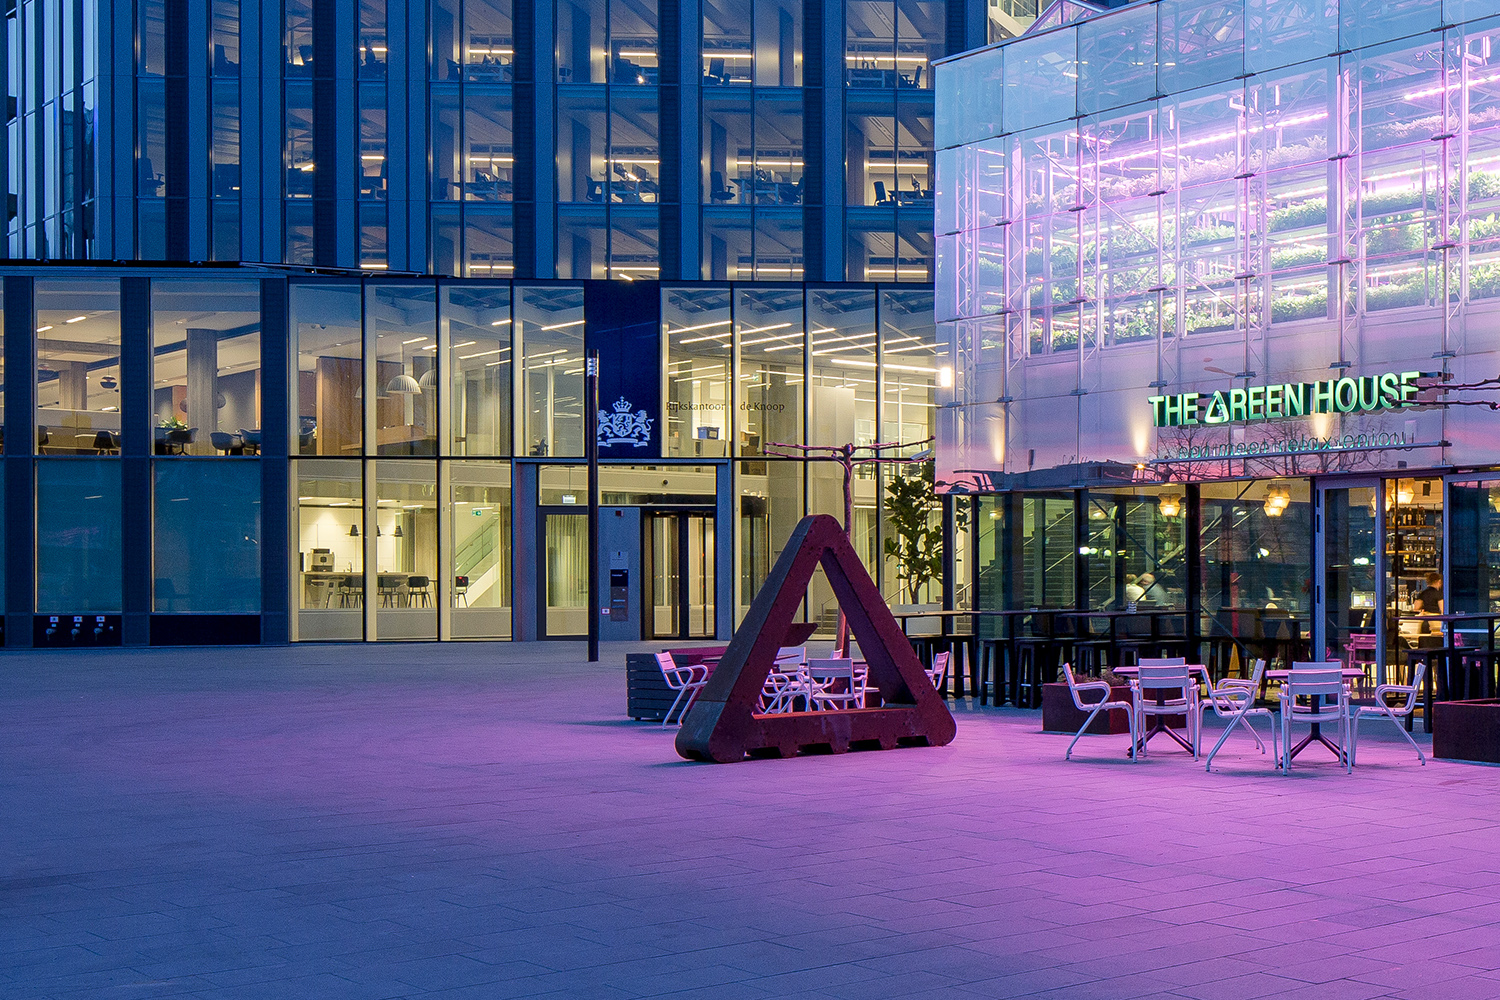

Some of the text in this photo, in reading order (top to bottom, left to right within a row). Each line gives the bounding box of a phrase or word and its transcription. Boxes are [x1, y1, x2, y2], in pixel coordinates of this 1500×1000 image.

[666, 401, 785, 412] Rijkskantoor de Knoop
[1148, 392, 1200, 427] THE
[1314, 370, 1421, 413] HOUSE
[1278, 433, 1332, 453] relax
